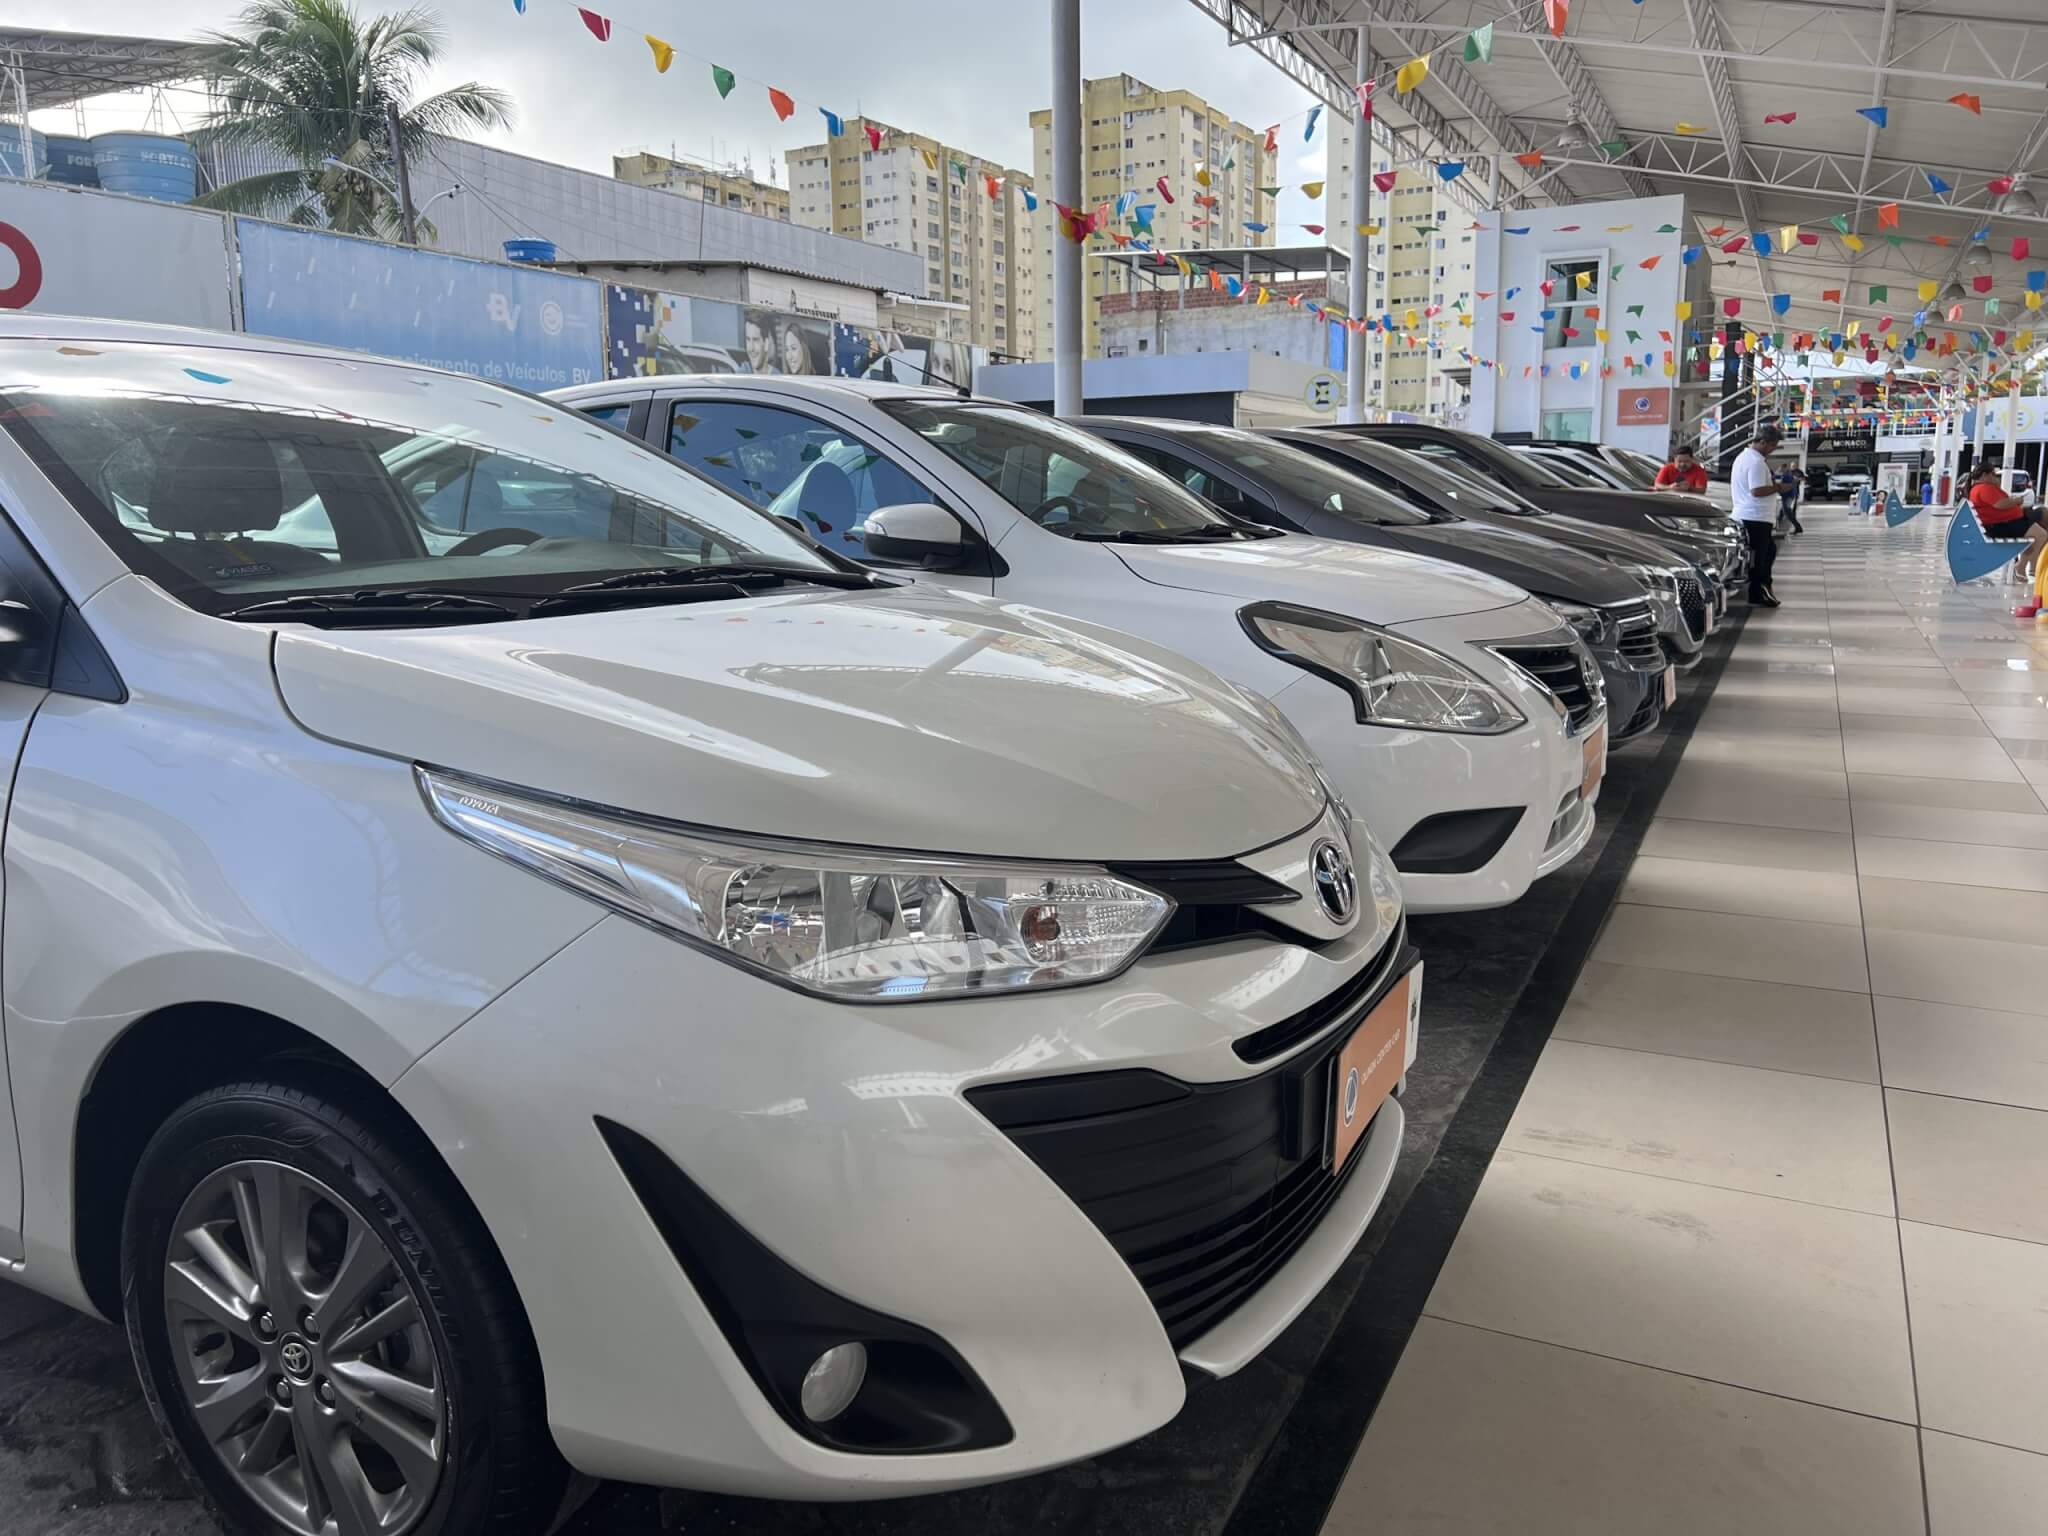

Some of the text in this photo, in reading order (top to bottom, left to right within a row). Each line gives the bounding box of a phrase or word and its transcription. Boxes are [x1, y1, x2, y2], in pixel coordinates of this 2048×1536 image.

[483, 359, 502, 378] de
[505, 360, 567, 384] Veículos
[572, 366, 592, 384] BV
